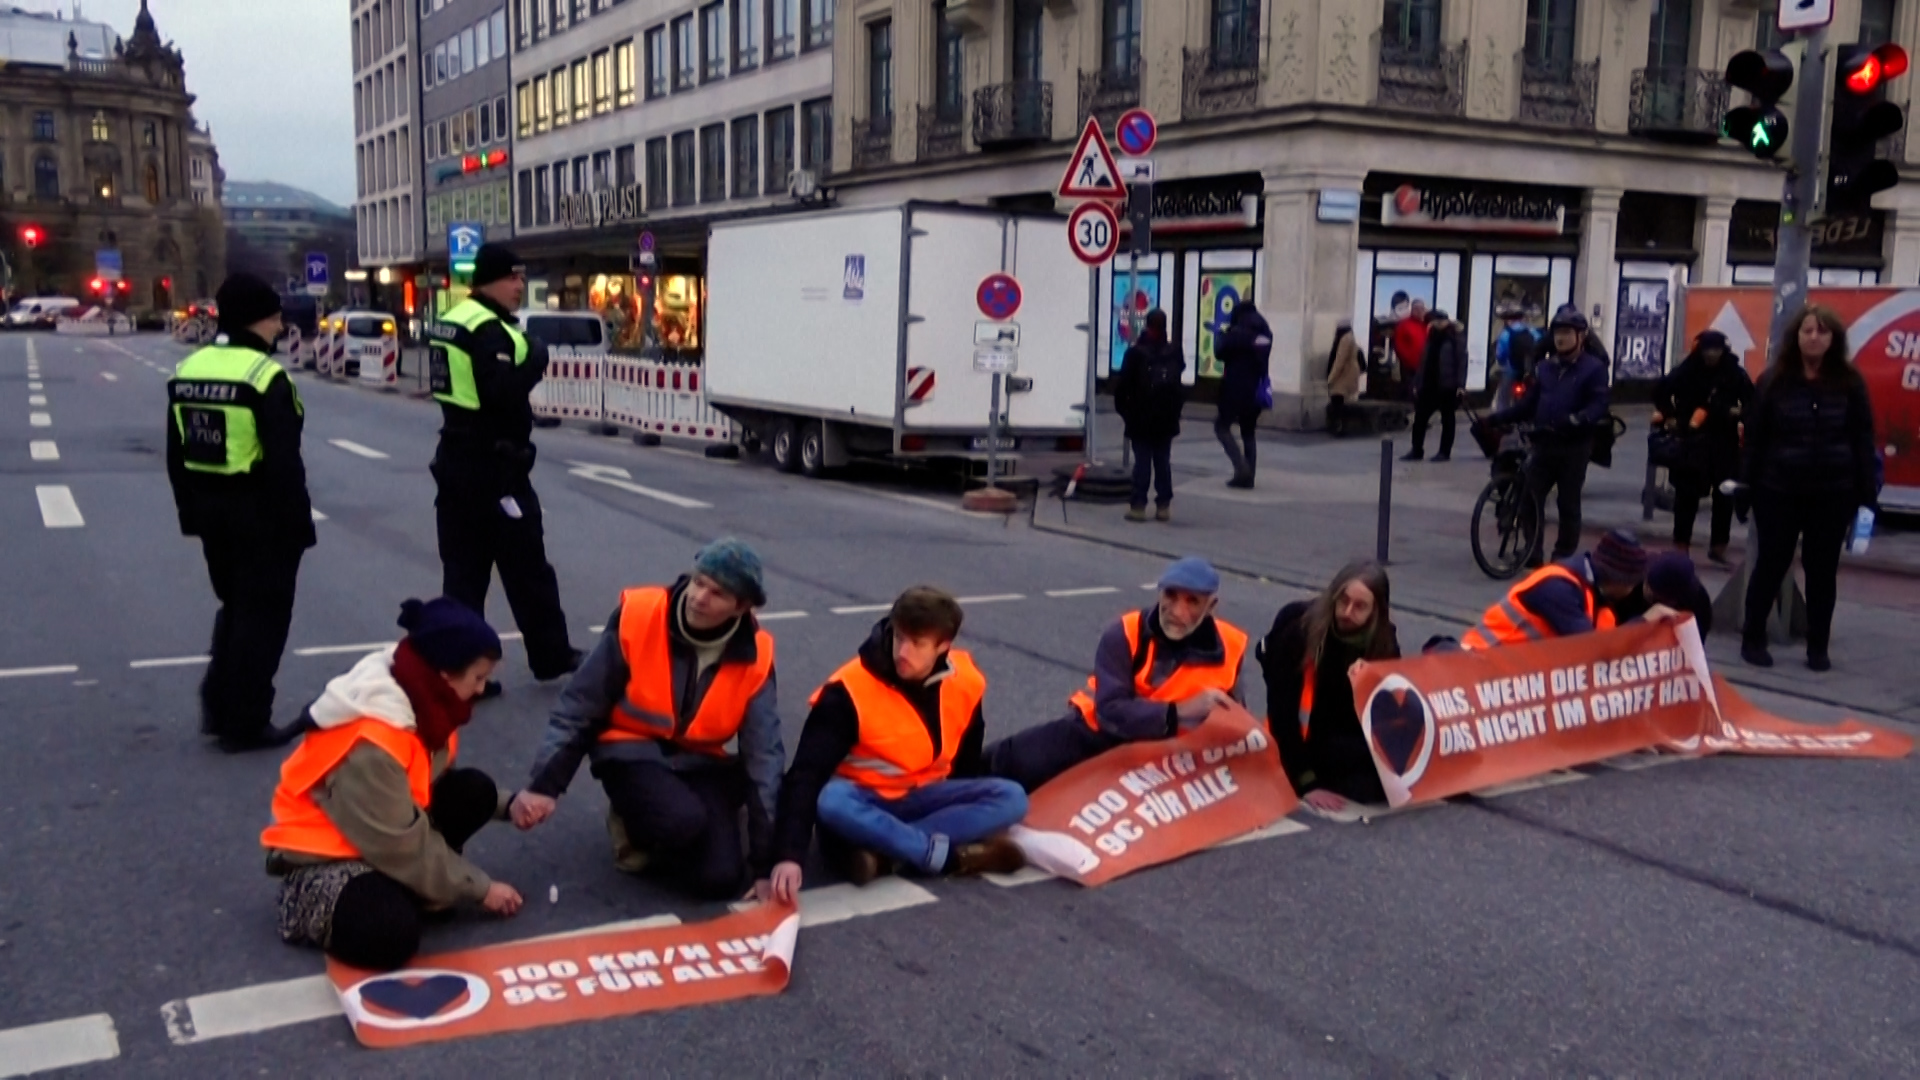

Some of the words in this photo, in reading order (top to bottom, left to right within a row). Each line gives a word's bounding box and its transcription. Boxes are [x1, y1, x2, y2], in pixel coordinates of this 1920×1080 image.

[1121, 189, 1243, 218] HVereinsbank
[1419, 189, 1558, 221] HypoVereinsbank
[1079, 219, 1108, 248] 30
[1885, 329, 1920, 361] SH
[175, 383, 237, 400] POLIZEI
[1902, 362, 1920, 391] G
[1475, 672, 1546, 711] WENN
[1551, 664, 1588, 696] DIE
[1593, 647, 1693, 688] REGIERU
[1440, 721, 1476, 756] DAS
[1475, 704, 1546, 747] NICHT
[1552, 697, 1587, 731] IM
[1590, 683, 1655, 722] GRIFF
[1659, 674, 1700, 706] HAT
[1068, 789, 1128, 835] 100
[1119, 751, 1195, 796] KM/H
[1182, 765, 1239, 811] ALLE
[493, 959, 579, 985] 100
[587, 943, 711, 973] KM/H
[716, 933, 771, 956] UN
[672, 955, 767, 984] ALLE
